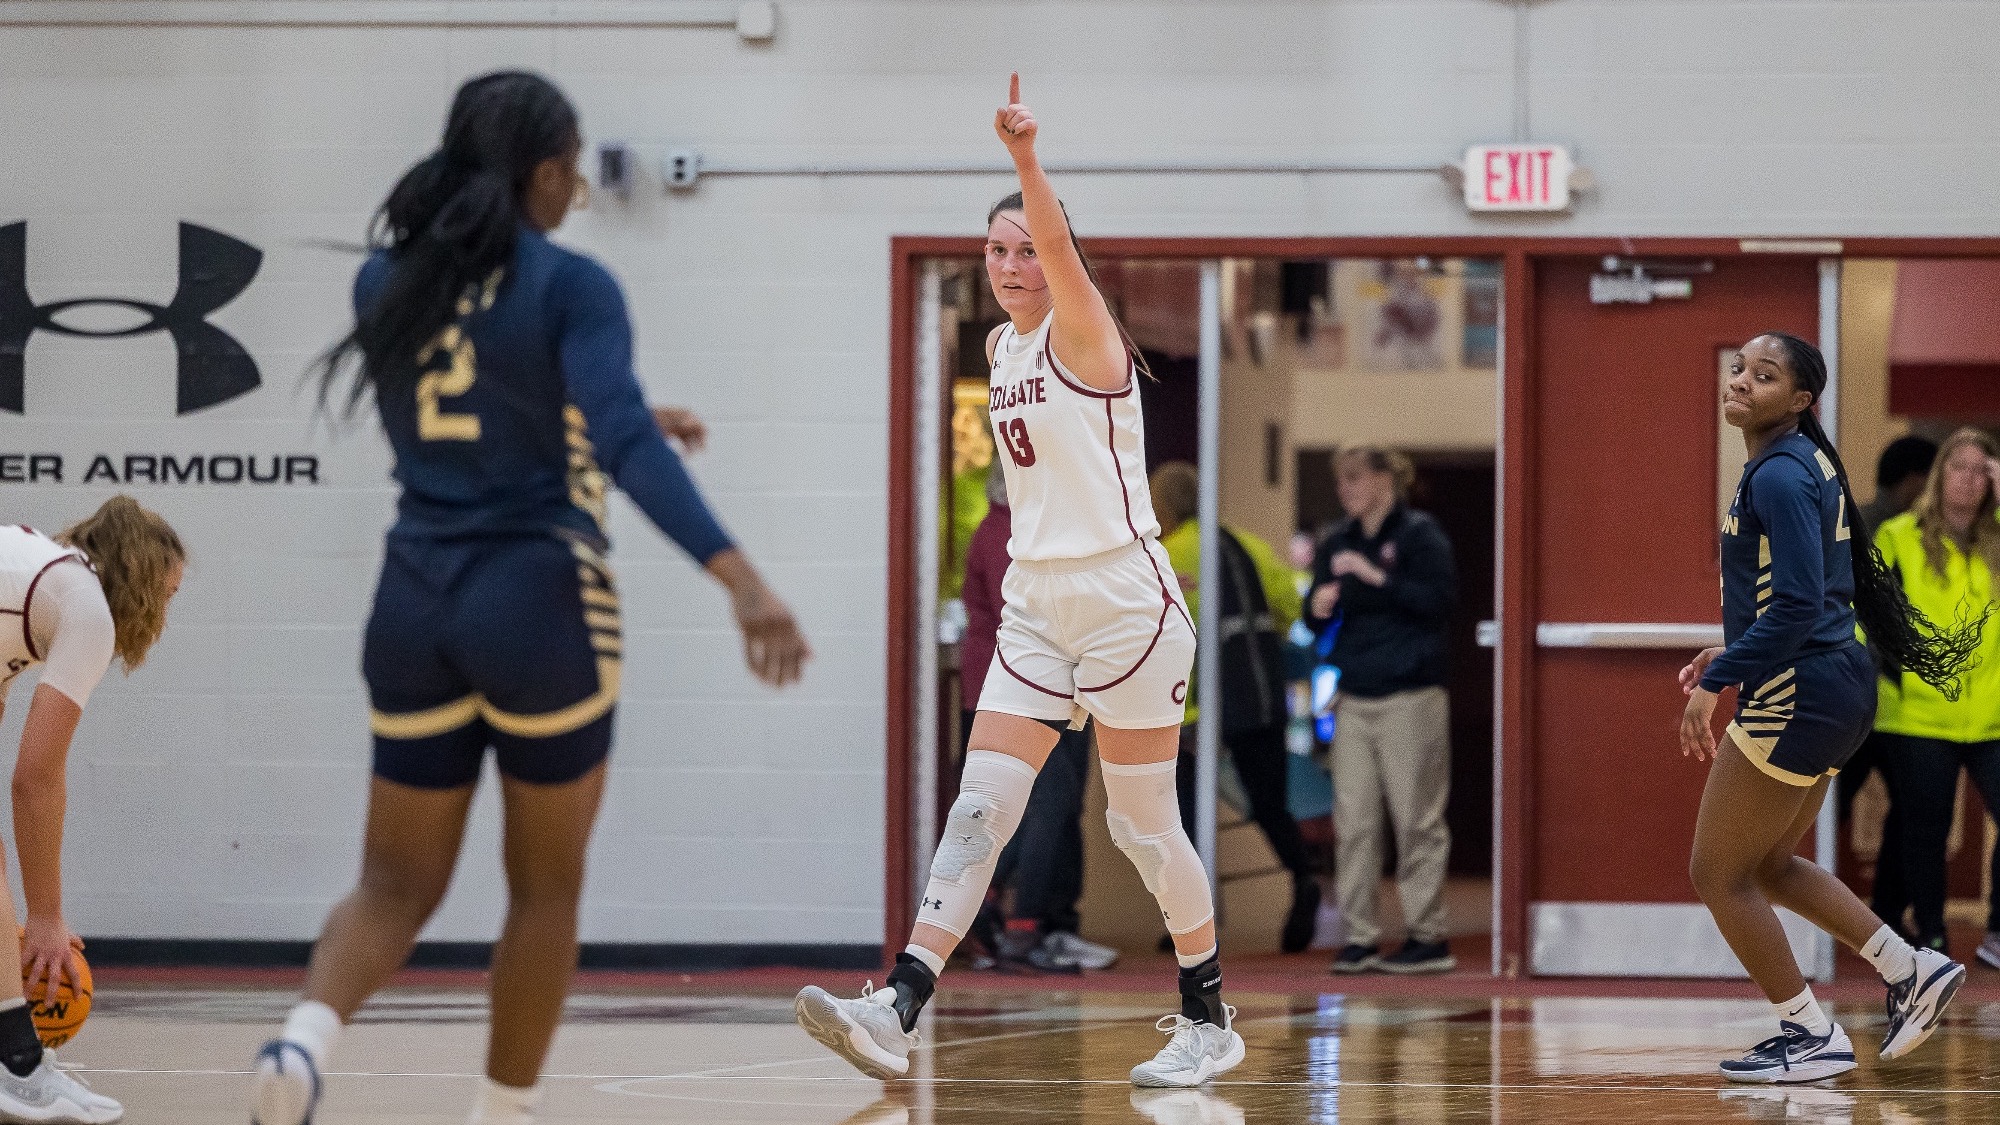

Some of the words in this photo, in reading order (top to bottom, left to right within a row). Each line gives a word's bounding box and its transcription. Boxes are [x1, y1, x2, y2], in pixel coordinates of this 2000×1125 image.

[1485, 150, 1553, 204] EXIT
[416, 324, 482, 441] 2
[990, 376, 1047, 412] COLGATE
[998, 417, 1037, 469] 13
[0, 453, 63, 484] ER
[82, 453, 319, 485] ARMOUR
[1171, 679, 1186, 706] C
